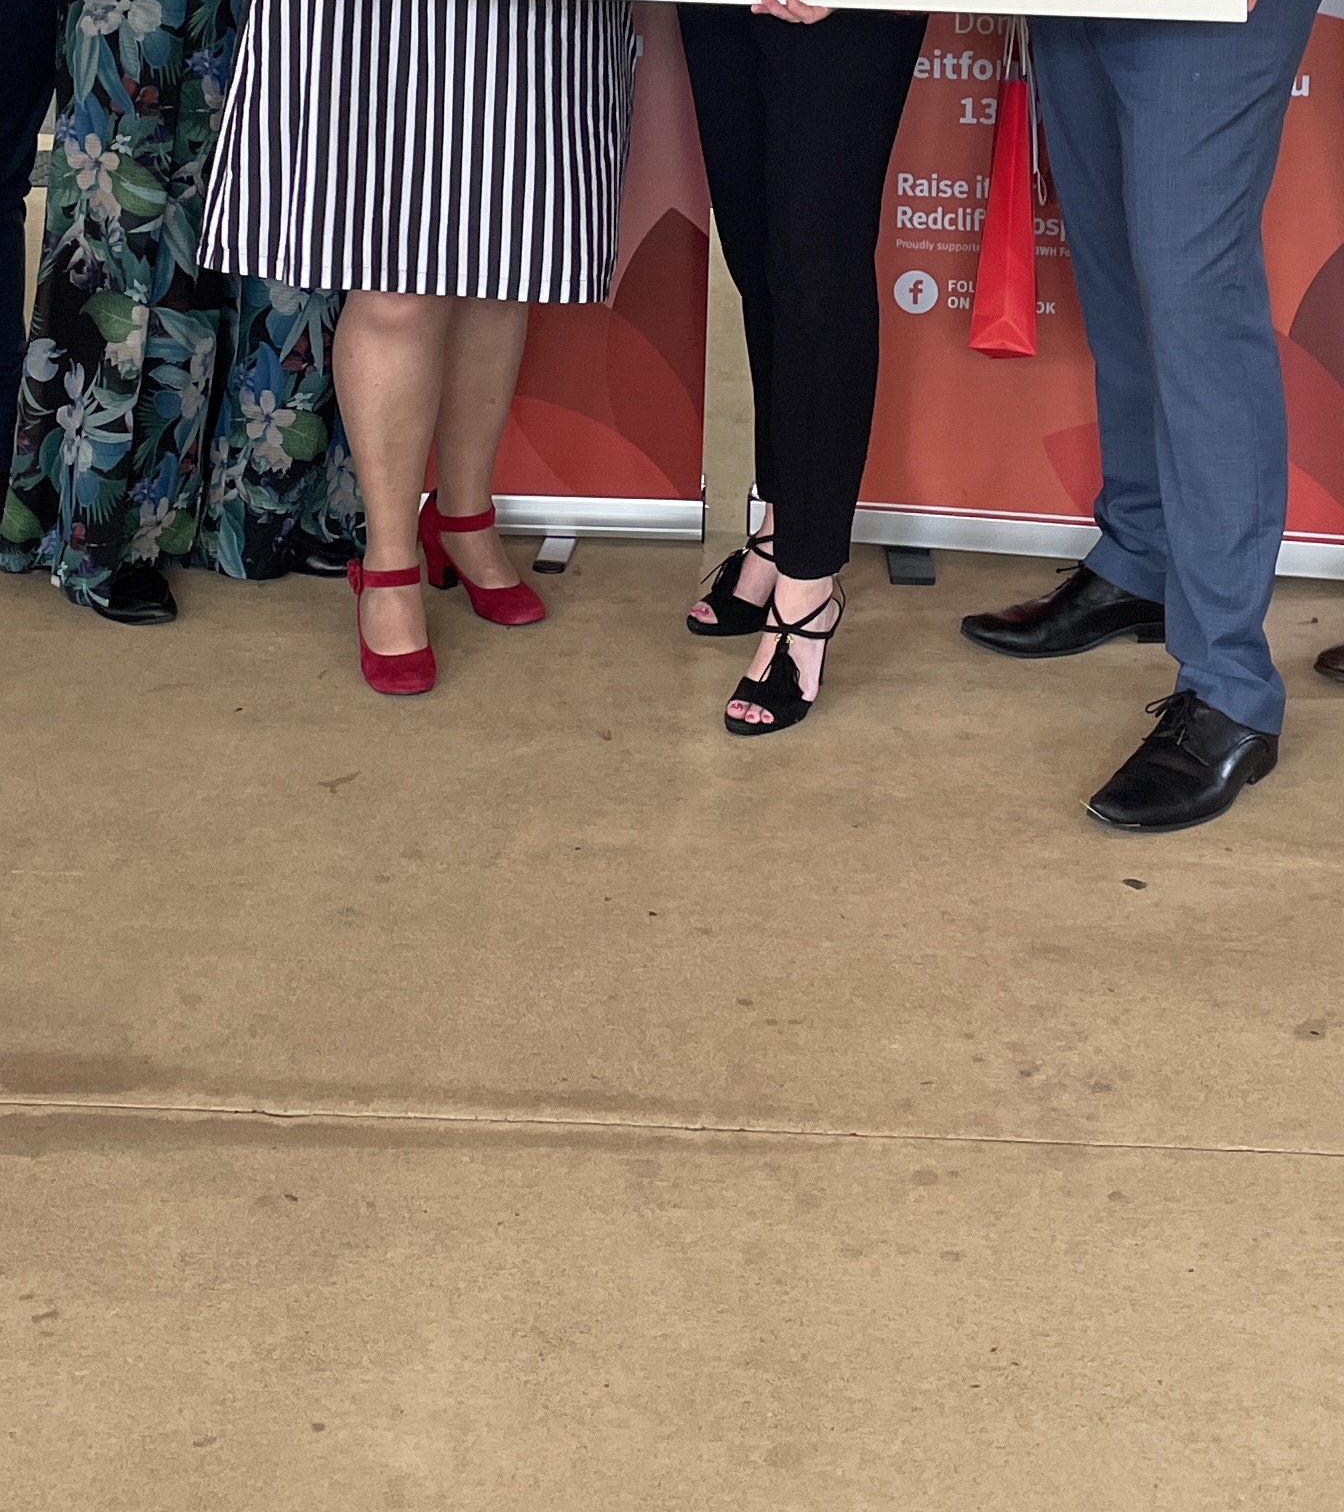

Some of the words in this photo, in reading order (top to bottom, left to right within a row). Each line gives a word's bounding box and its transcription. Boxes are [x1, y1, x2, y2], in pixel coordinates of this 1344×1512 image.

[897, 173, 968, 198] Raise
[896, 206, 986, 232] Redclif
[896, 238, 934, 251] Proudly
[936, 241, 980, 253] support
[947, 296, 970, 309] ON
